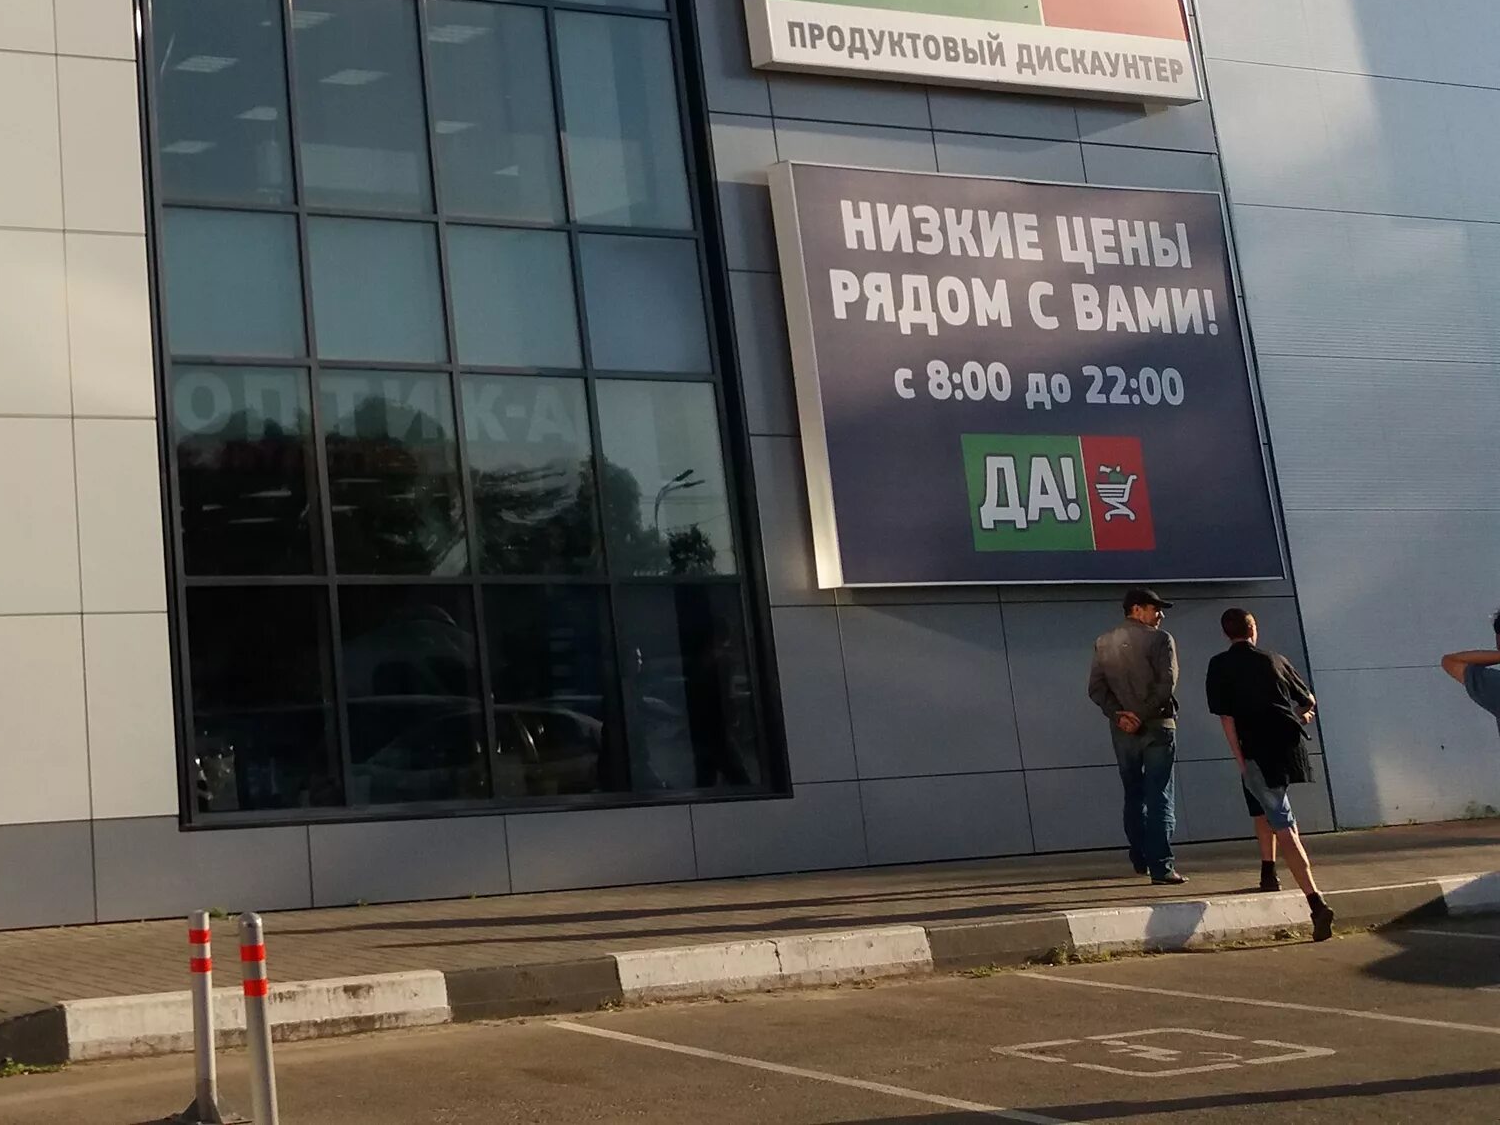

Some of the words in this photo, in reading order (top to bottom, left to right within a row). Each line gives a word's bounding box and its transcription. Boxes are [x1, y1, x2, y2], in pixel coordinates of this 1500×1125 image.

[787, 19, 1007, 69] ПРОДУКТОВЫЙ
[1015, 42, 1184, 85] ДИСКАУНТЕР
[839, 199, 1044, 262] НИЗКИЕ
[1055, 214, 1193, 274] ЦЕНЫ
[828, 268, 1013, 336] РЯДОМ
[1027, 281, 1060, 331] С
[1071, 282, 1220, 336] ВАМИ!
[894, 367, 916, 399] с
[926, 359, 1012, 402] 8:00
[1025, 372, 1072, 410] до
[1082, 364, 1185, 406] 22:00
[979, 454, 1081, 530] ДА!
